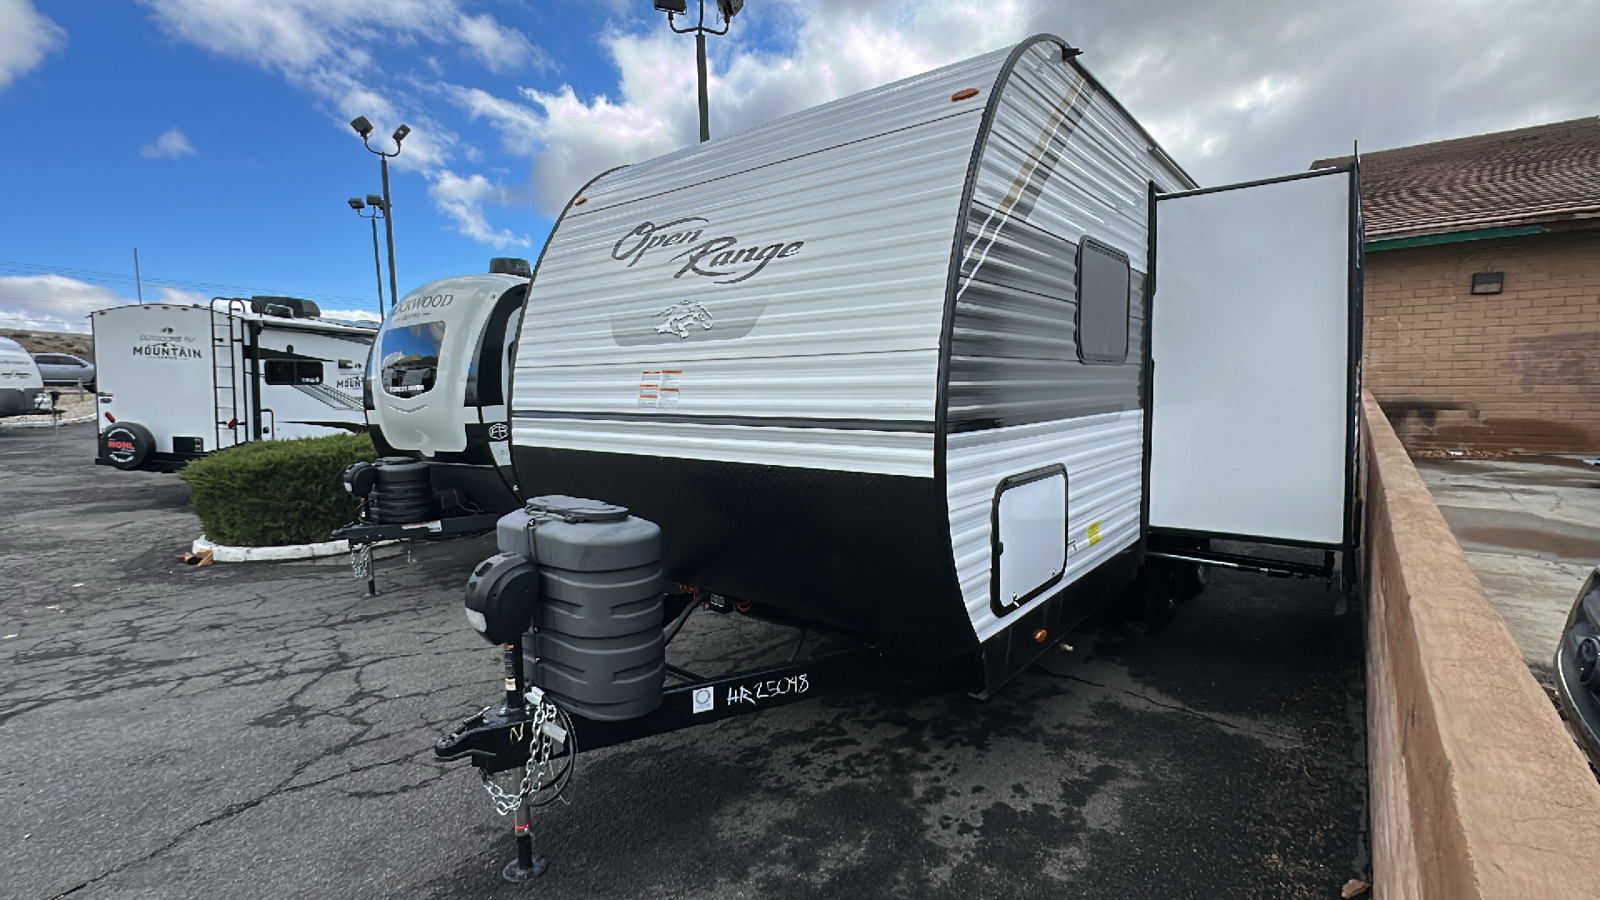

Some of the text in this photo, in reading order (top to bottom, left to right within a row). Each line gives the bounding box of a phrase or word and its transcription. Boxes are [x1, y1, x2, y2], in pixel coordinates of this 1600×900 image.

[611, 216, 804, 284] Open Range
[132, 346, 203, 359] MOUNTAIN
[727, 673, 809, 706] HR25048
